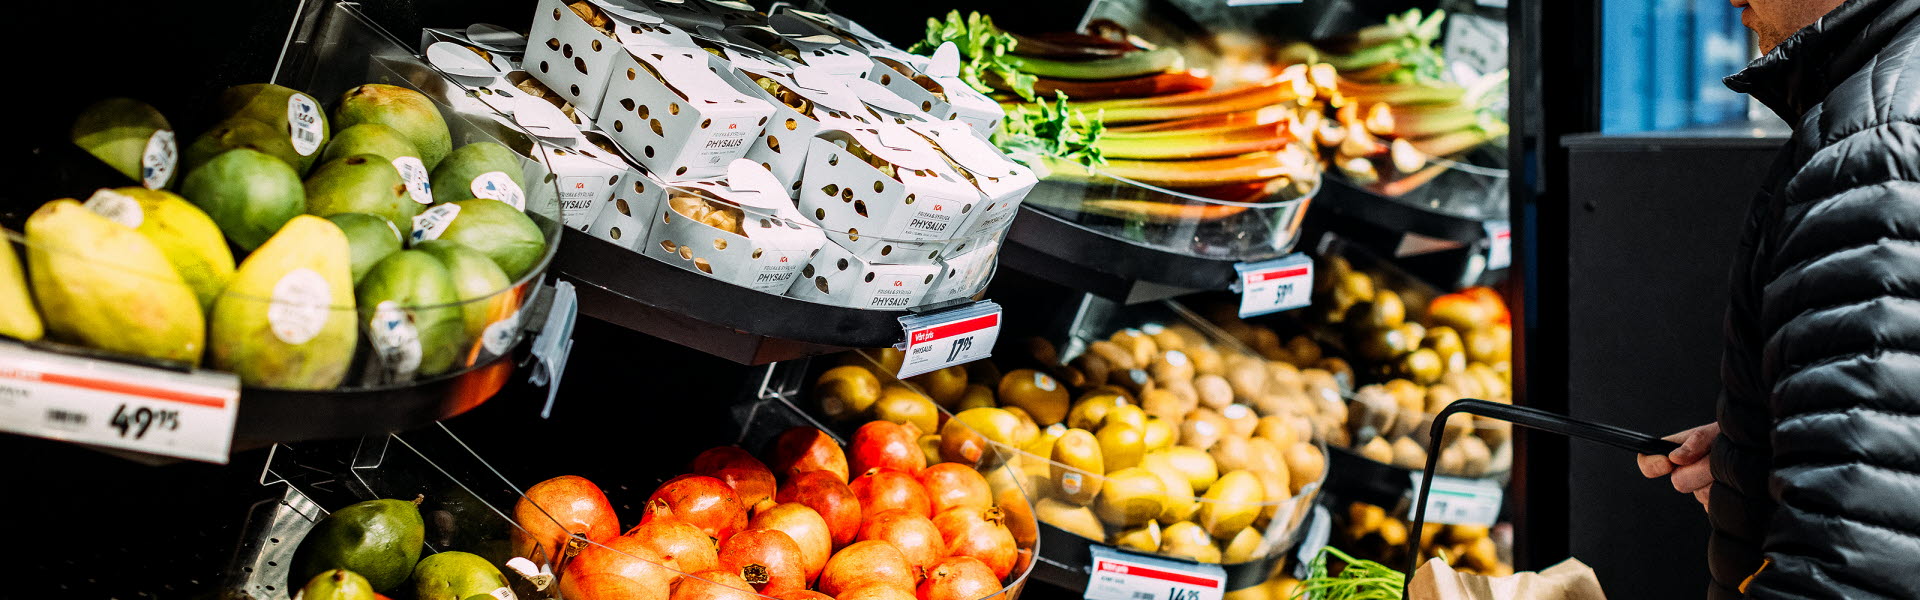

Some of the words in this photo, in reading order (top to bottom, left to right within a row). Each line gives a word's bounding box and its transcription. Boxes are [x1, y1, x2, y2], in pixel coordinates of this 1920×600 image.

[706, 139, 743, 148] PHYSALIS
[910, 218, 947, 231] PHYSALIS
[757, 272, 793, 282] PHYSALIS
[871, 297, 909, 306] PHYSALIS
[913, 345, 933, 355] PHYSALIS
